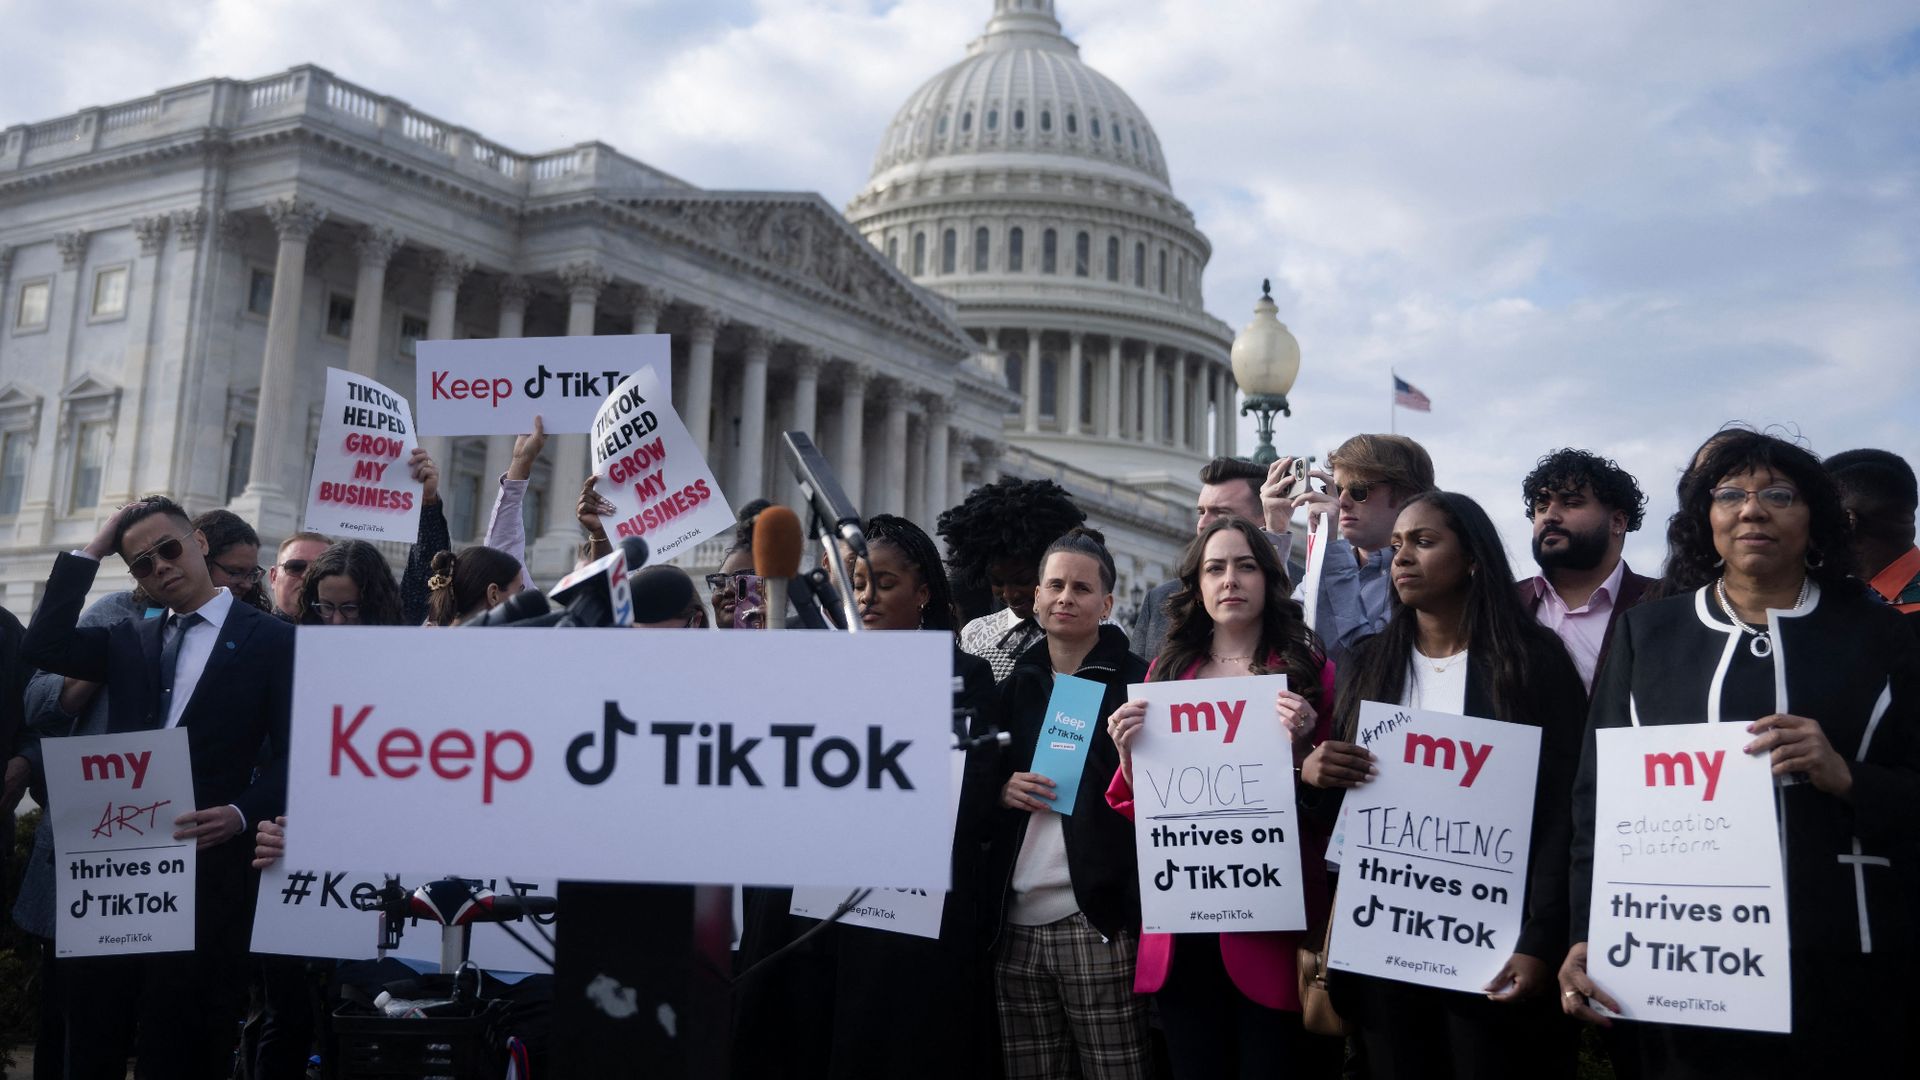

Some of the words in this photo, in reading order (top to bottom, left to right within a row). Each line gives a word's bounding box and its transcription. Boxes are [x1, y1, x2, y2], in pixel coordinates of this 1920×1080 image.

[347, 382, 401, 415] TIKTOK
[432, 371, 513, 407] Keep
[557, 371, 631, 397] TikT
[343, 405, 406, 435] HELPED
[597, 385, 647, 438] TIKTOK
[345, 432, 404, 459] GROW
[597, 411, 658, 464] HELPED
[354, 460, 388, 482] MY
[609, 436, 666, 484] GROW
[319, 481, 414, 511] BUSINESS
[634, 469, 667, 503] MY
[616, 478, 711, 538] BUSINESS
[340, 521, 385, 533] #KeepTikTok
[656, 527, 702, 555] #KeepTikTok
[1055, 711, 1086, 731] Keep
[1057, 729, 1084, 742] TikTok
[1170, 700, 1247, 744] my
[82, 751, 152, 789] my
[331, 705, 533, 805] Keep
[651, 722, 916, 791] TikTok
[1404, 732, 1493, 788] my
[1146, 764, 1265, 808] VOICE
[1644, 750, 1725, 801] my
[92, 800, 171, 839] ART
[1616, 814, 1731, 835] education
[1151, 824, 1244, 848] thrives
[1251, 827, 1285, 843] on
[1358, 806, 1514, 865] TEACHING
[1619, 836, 1721, 862] platform
[70, 858, 151, 880] thrives
[158, 858, 185, 874] on
[1184, 863, 1282, 890] TikTok
[1358, 857, 1462, 896] thrives
[1471, 882, 1508, 904] on
[97, 891, 178, 917] TikTok
[1190, 910, 1254, 923] #KeepTikTok
[1611, 893, 1722, 923] thrives
[1732, 904, 1771, 924] on
[98, 934, 153, 945] #KeepTikTok
[1389, 905, 1496, 950] TikTok
[1385, 955, 1458, 977] #KeepTikTok
[1646, 942, 1765, 977] TikTok
[1646, 995, 1727, 1012] #KeepTikTok
